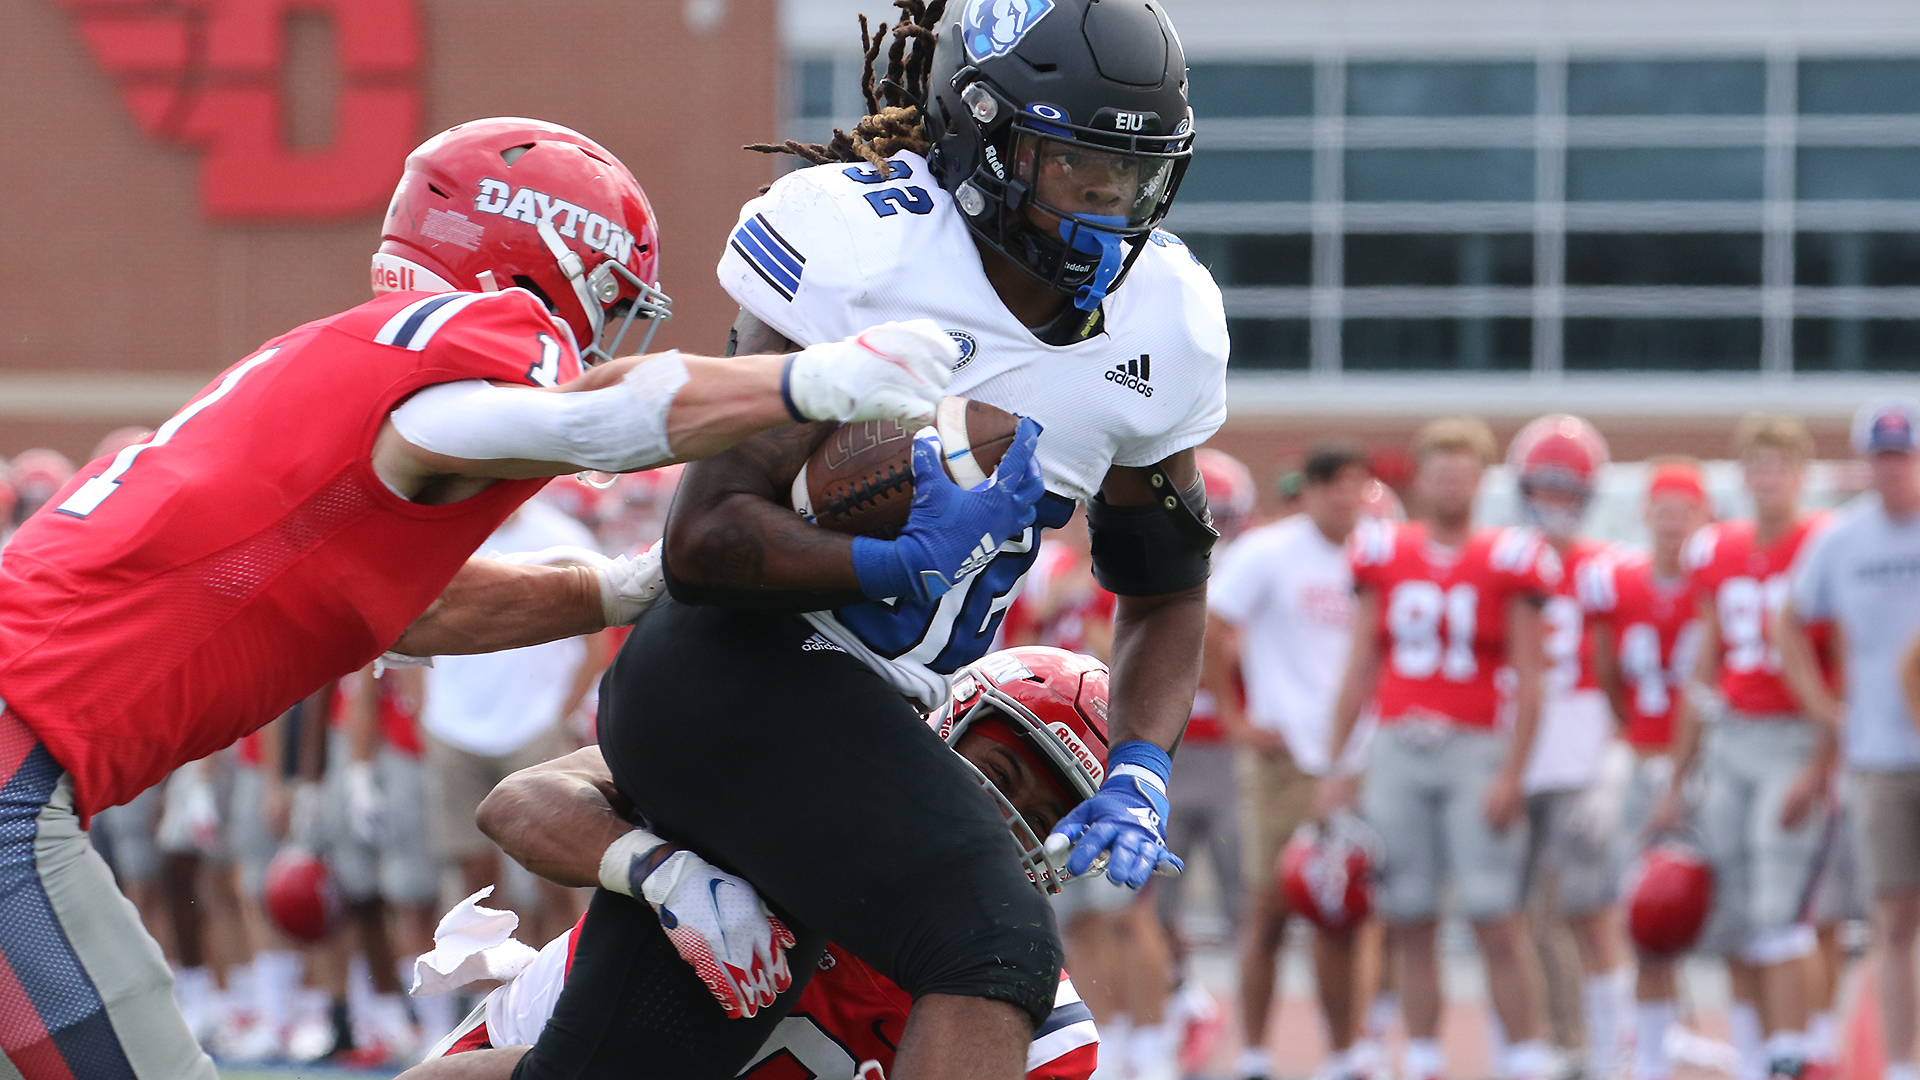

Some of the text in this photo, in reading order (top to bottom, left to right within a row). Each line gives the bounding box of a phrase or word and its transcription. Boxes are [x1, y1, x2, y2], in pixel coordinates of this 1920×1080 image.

[1115, 112, 1143, 132] EIU
[842, 160, 936, 218] 32
[474, 177, 635, 266] DAYTON
[525, 331, 561, 388] 1
[1104, 370, 1154, 398] adidas
[54, 344, 283, 520] 1
[1055, 727, 1101, 780] Riddell
